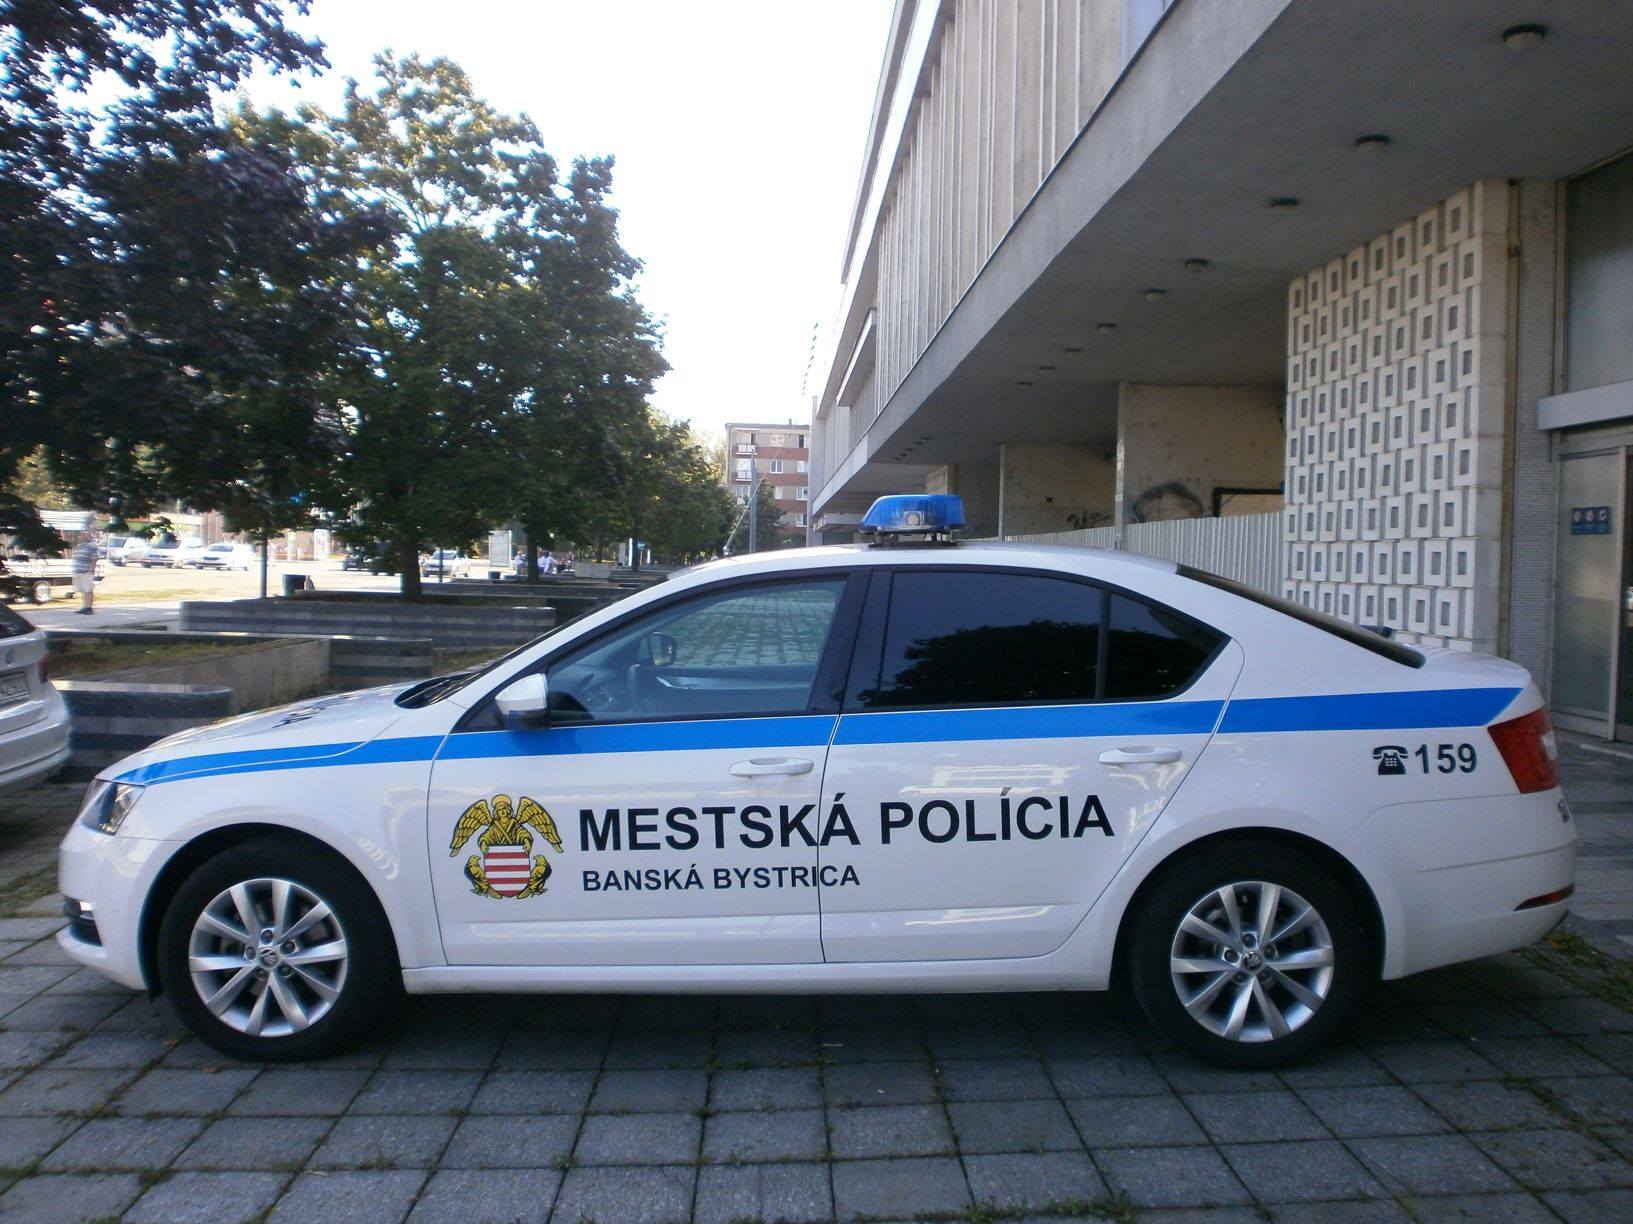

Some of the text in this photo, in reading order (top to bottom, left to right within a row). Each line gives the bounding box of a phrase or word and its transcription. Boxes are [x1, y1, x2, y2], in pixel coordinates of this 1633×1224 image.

[1414, 742, 1477, 774] 159
[579, 786, 1115, 852] MESTSKÁ POLÍCIA
[582, 863, 861, 892] BANSKÁ BYSTRICA
